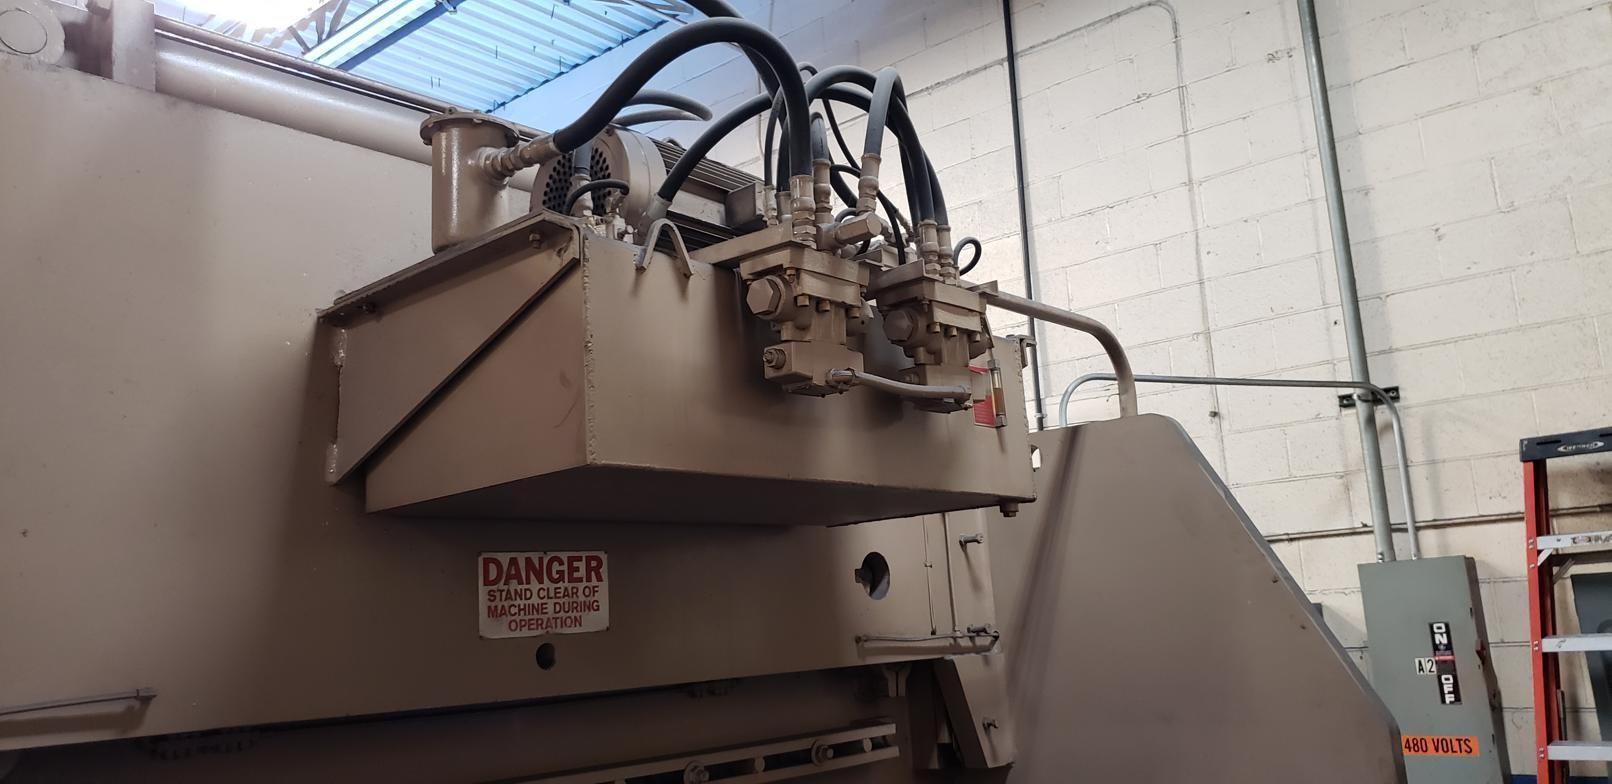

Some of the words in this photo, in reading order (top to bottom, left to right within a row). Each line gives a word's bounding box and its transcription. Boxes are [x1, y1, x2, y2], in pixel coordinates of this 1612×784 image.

[482, 555, 603, 586] DANGER
[487, 588, 533, 602] STAND
[537, 587, 579, 600] CLEAR
[582, 585, 600, 598] OF
[487, 602, 548, 618] MACHINE
[553, 600, 600, 615] DURING
[508, 615, 582, 632] OPERATION
[1433, 623, 1448, 644] ON
[1417, 659, 1435, 673] A2
[1441, 674, 1455, 704] OFF
[1404, 738, 1428, 753] 480
[1432, 738, 1473, 754] VOLTS
